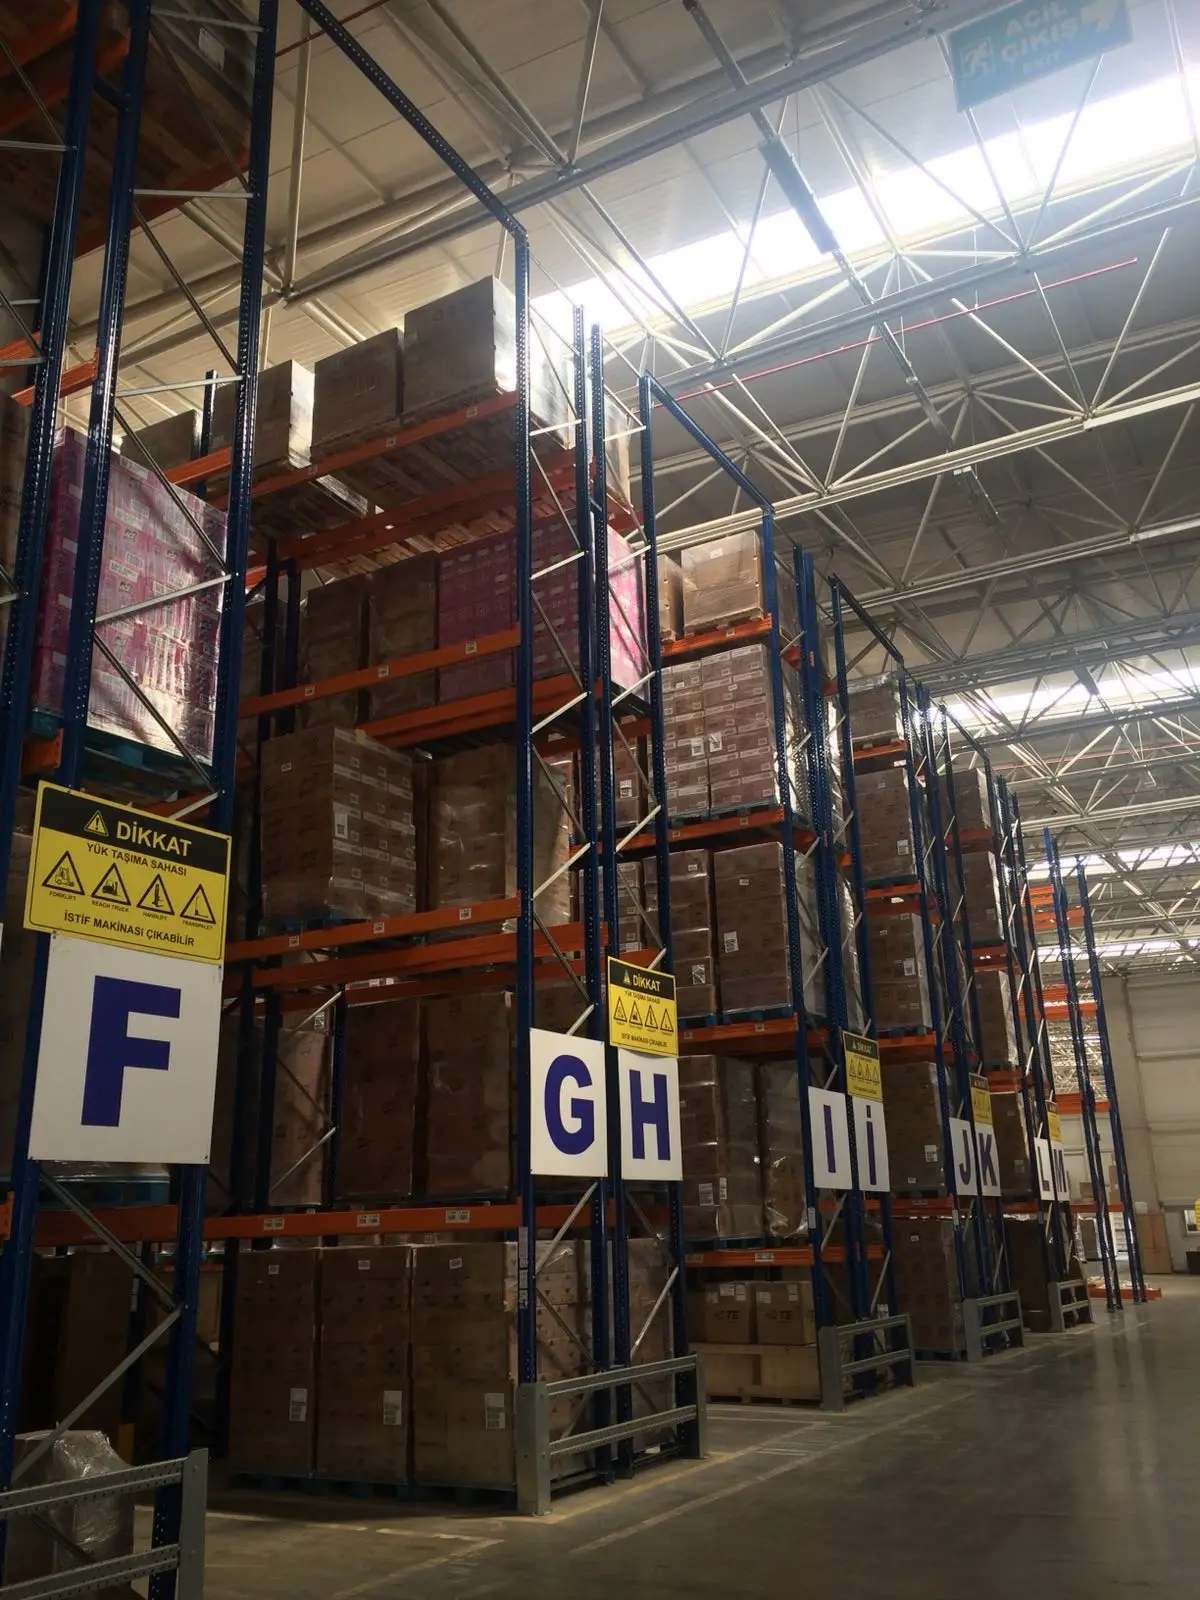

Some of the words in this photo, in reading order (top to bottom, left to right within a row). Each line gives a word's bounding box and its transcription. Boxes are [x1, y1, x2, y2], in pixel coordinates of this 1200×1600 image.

[87, 842, 108, 857] YÜK
[111, 849, 148, 867] TAŞIMA
[151, 860, 187, 876] SAHASI
[116, 821, 192, 857] DİKKAT
[64, 909, 90, 925] İSTİF
[93, 918, 144, 937] MAKİNASI
[146, 928, 194, 947] ÇIKABİLİR
[632, 973, 661, 992] DİKKAT
[81, 975, 181, 1127] F
[544, 1054, 595, 1155] G
[629, 1069, 671, 1161] H
[959, 1129, 971, 1185] J
[978, 1132, 998, 1187] K
[1036, 1144, 1050, 1192] L
[1052, 1148, 1067, 1193] M
